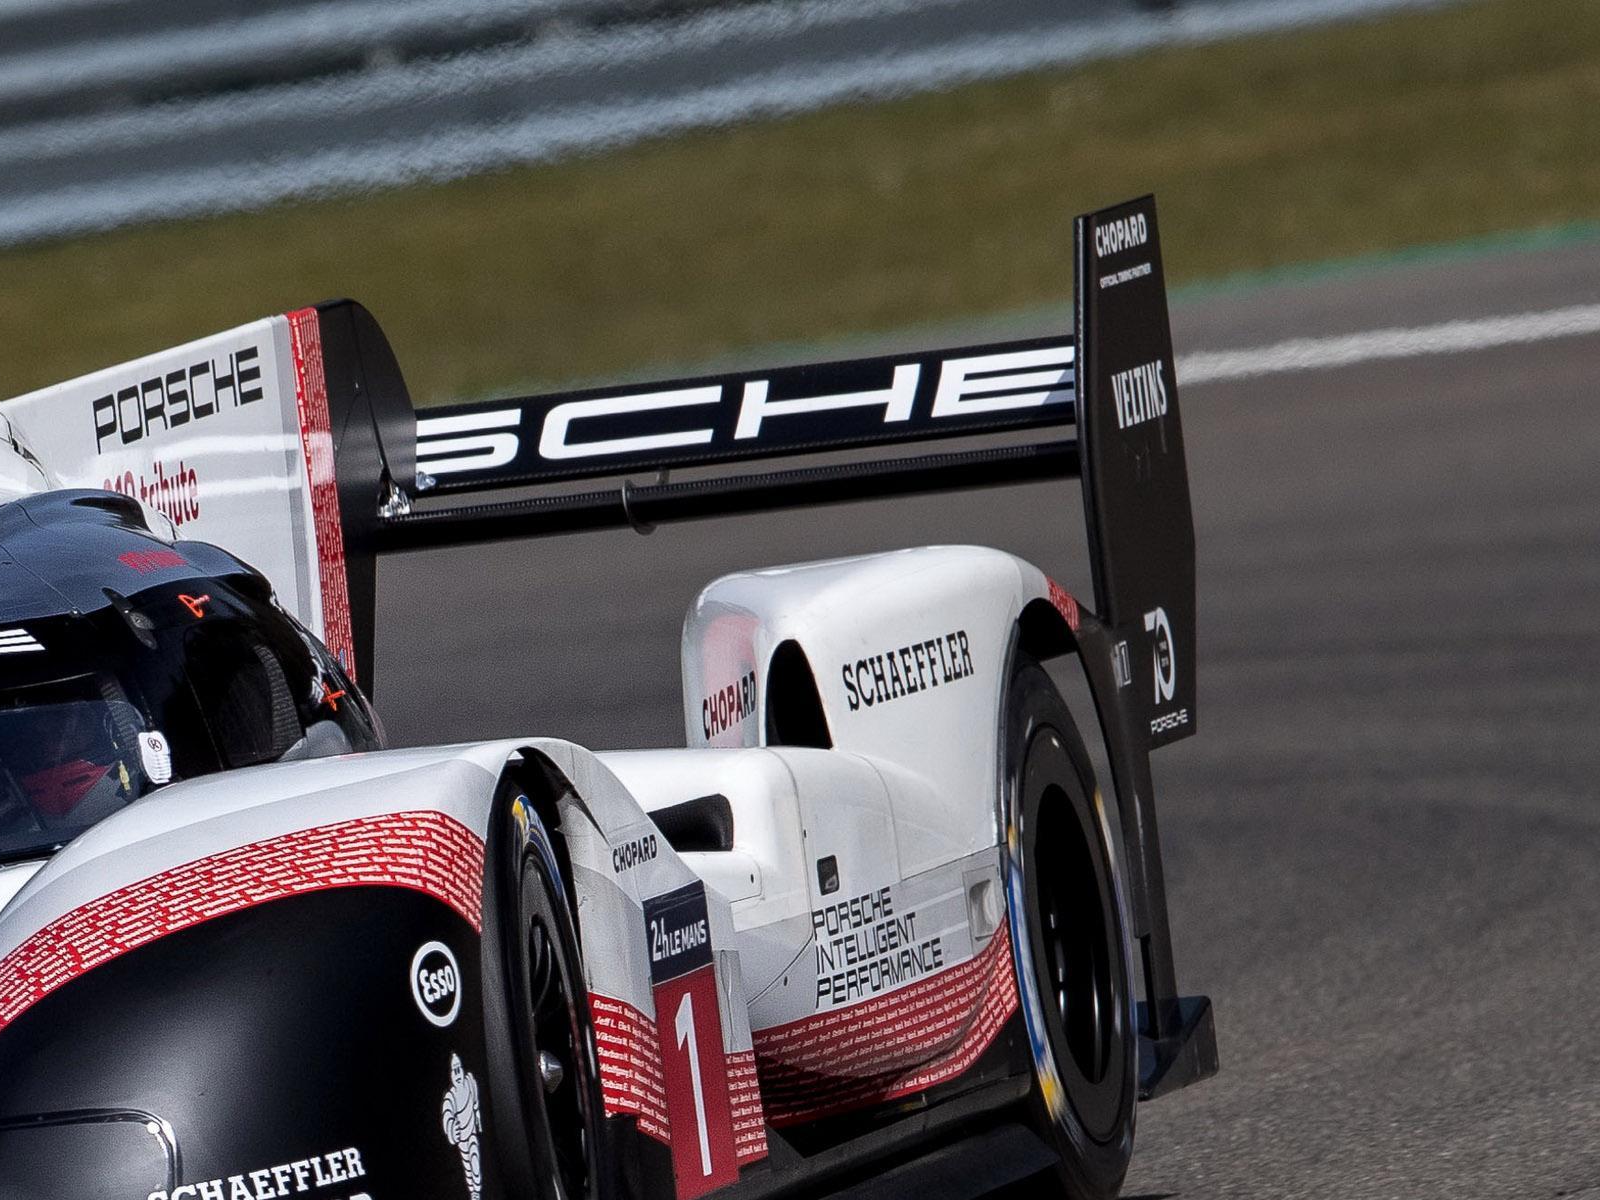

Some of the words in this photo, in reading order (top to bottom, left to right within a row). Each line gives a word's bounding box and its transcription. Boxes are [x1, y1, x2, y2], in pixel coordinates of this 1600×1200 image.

[1095, 213, 1148, 258] CHOPARD
[92, 346, 264, 455] PORSCHE
[1111, 359, 1168, 429] VELTINS
[842, 630, 974, 711] SCHAEFFLER
[703, 670, 756, 740] CHOPARD
[1150, 708, 1189, 735] PORSCHE
[612, 834, 658, 873] CHOPARD
[670, 930, 681, 956] LE
[681, 920, 707, 951] MANS
[811, 886, 894, 942] PORSCHE
[816, 912, 916, 975] INTELLIGENT
[816, 937, 944, 1009] PERFORMANCE
[675, 992, 713, 1176] 1
